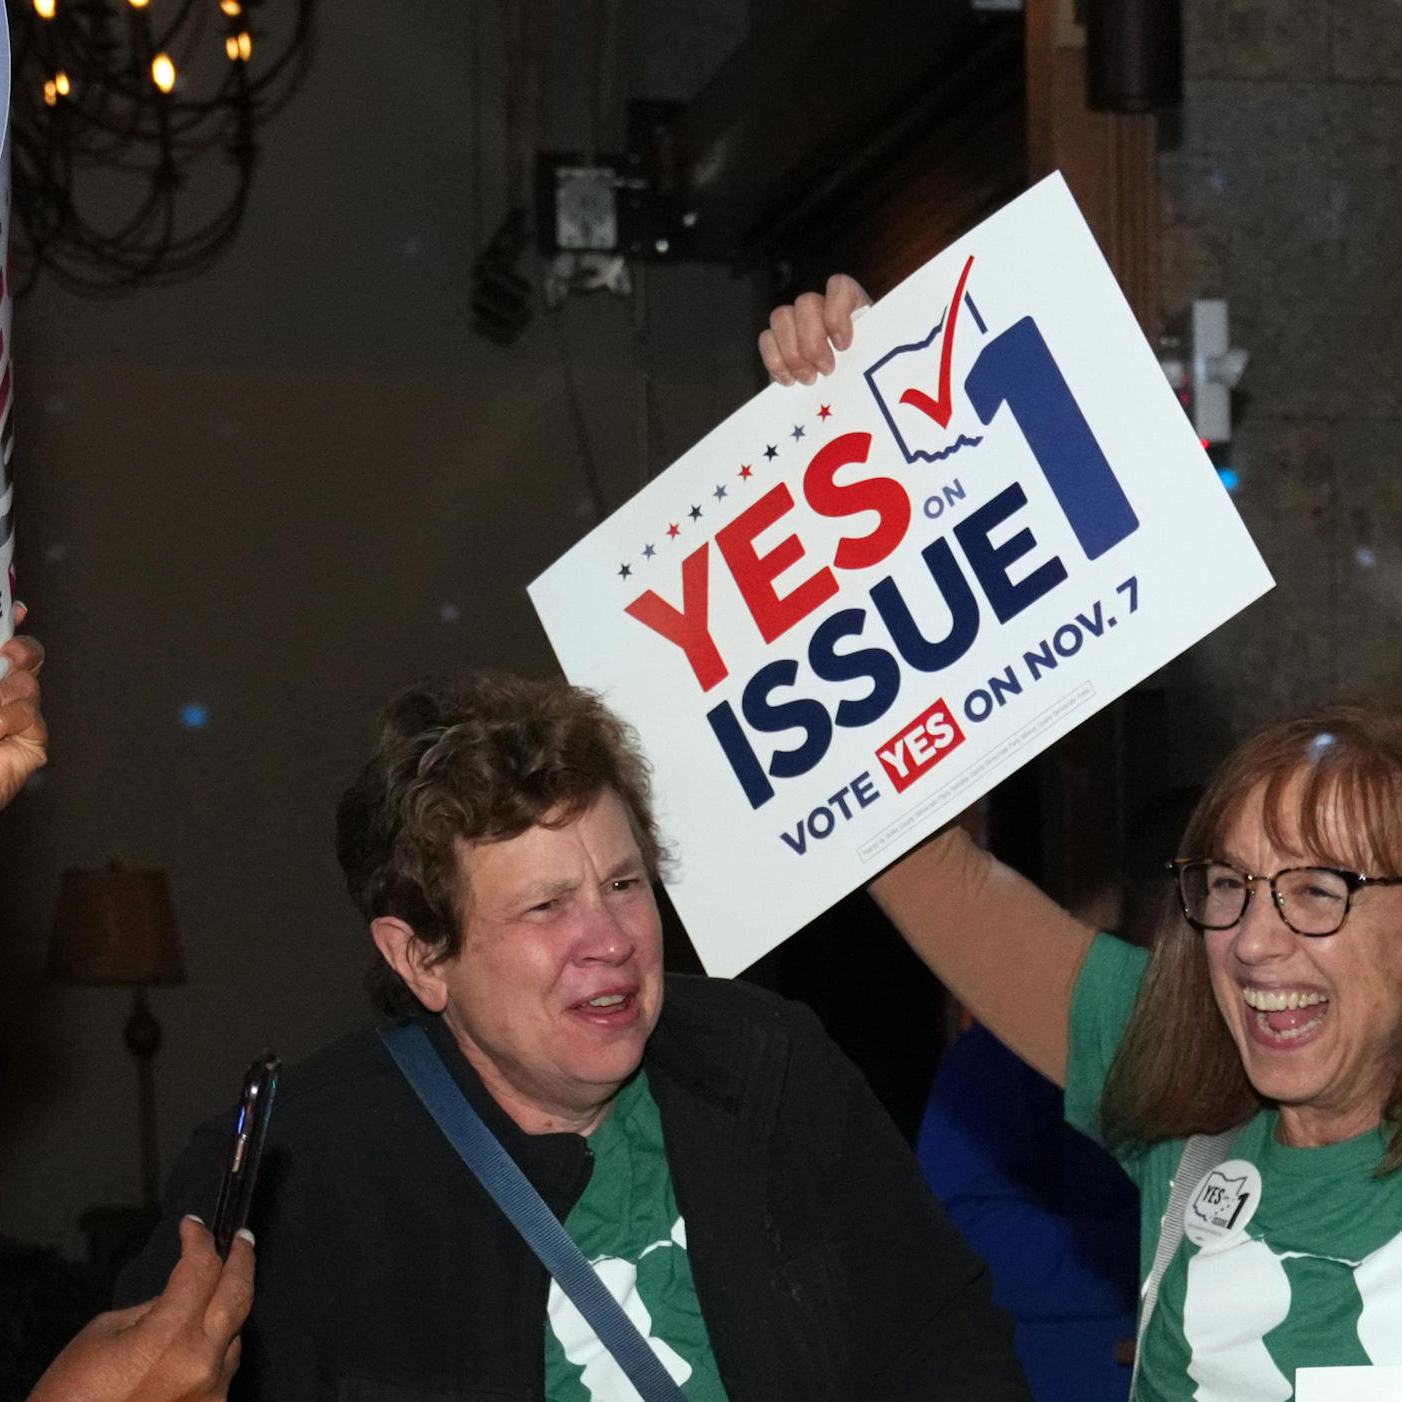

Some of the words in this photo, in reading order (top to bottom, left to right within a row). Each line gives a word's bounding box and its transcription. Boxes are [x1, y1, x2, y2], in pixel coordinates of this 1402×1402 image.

[626, 432, 911, 691] YES
[924, 479, 965, 518] ON
[707, 482, 1068, 810] ISSUE
[964, 316, 1139, 560] 1
[780, 771, 881, 856] VOTE
[880, 712, 954, 777] YES
[964, 666, 1022, 722] ON
[1023, 601, 1118, 680] NOV.
[1116, 576, 1141, 613] 7
[1203, 1185, 1225, 1205] YES
[1226, 1192, 1250, 1229] 1
